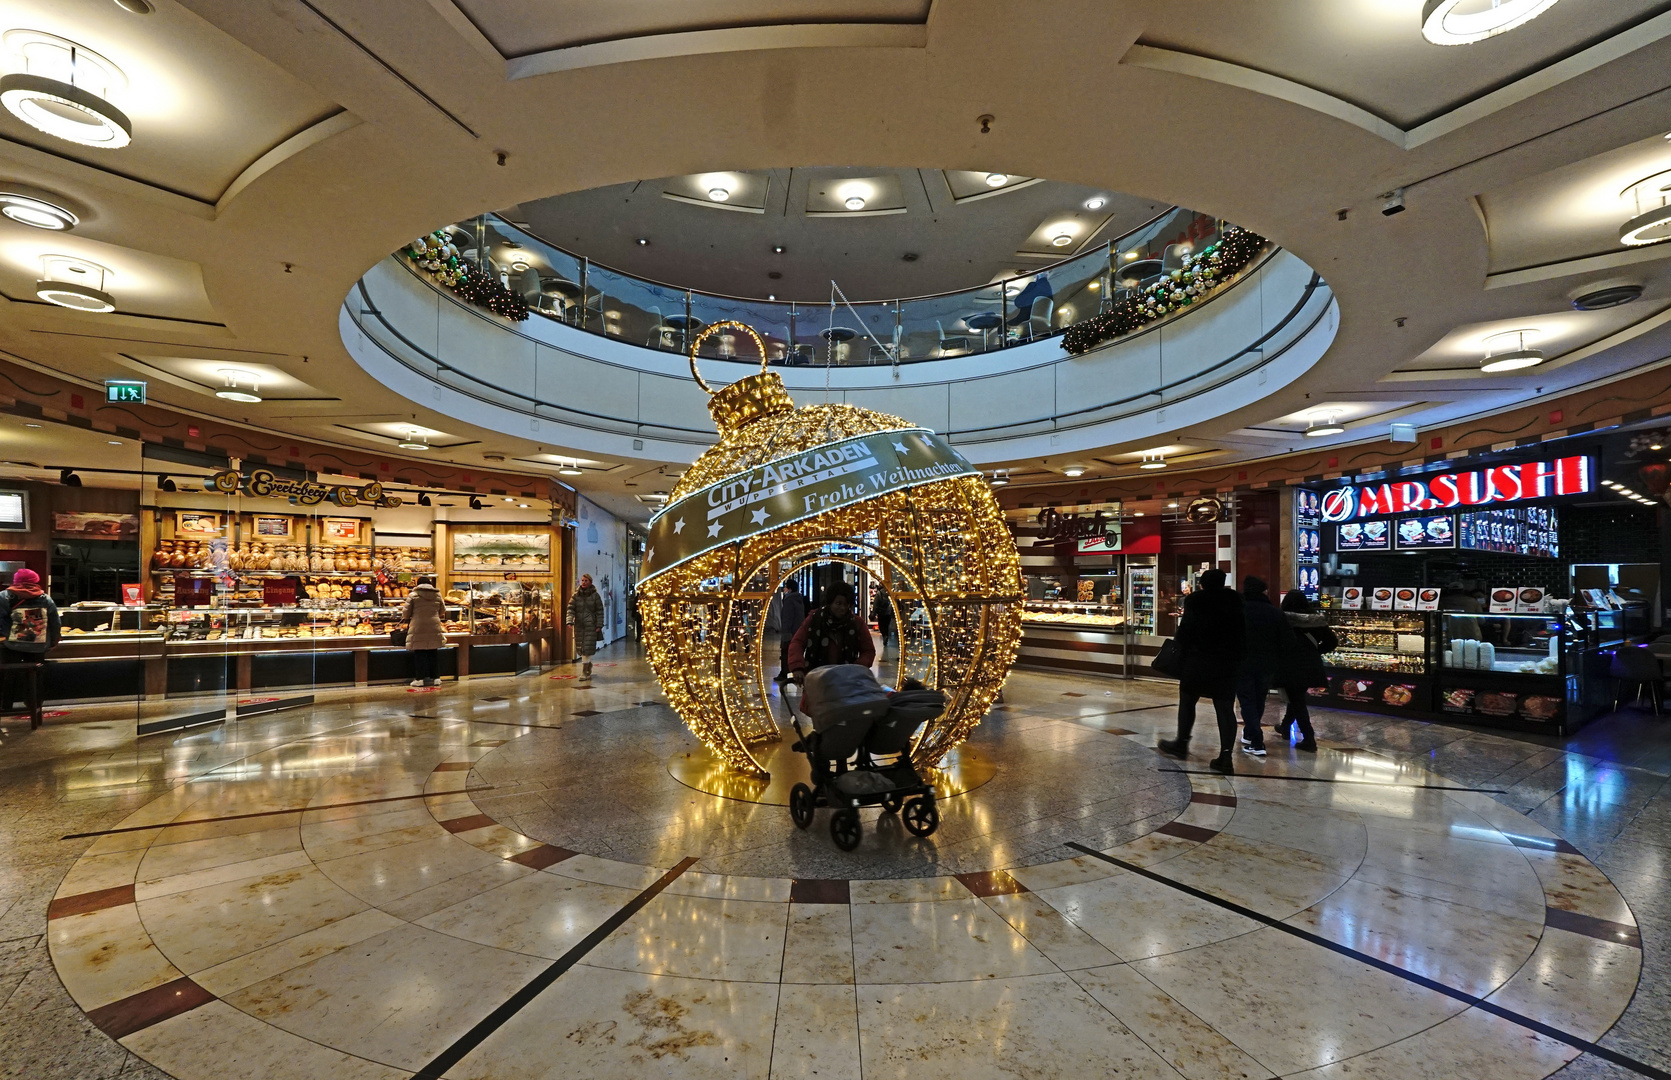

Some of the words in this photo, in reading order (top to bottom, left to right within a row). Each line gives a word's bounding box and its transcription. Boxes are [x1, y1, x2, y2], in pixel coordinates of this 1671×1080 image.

[251, 471, 328, 505] Evertzberg
[707, 441, 873, 507] CITY-ARKADEN
[724, 466, 848, 512] WUPPERTAL
[802, 484, 866, 514] Frohe
[868, 461, 964, 490] Weihnachten
[265, 586, 295, 595] Eingang
